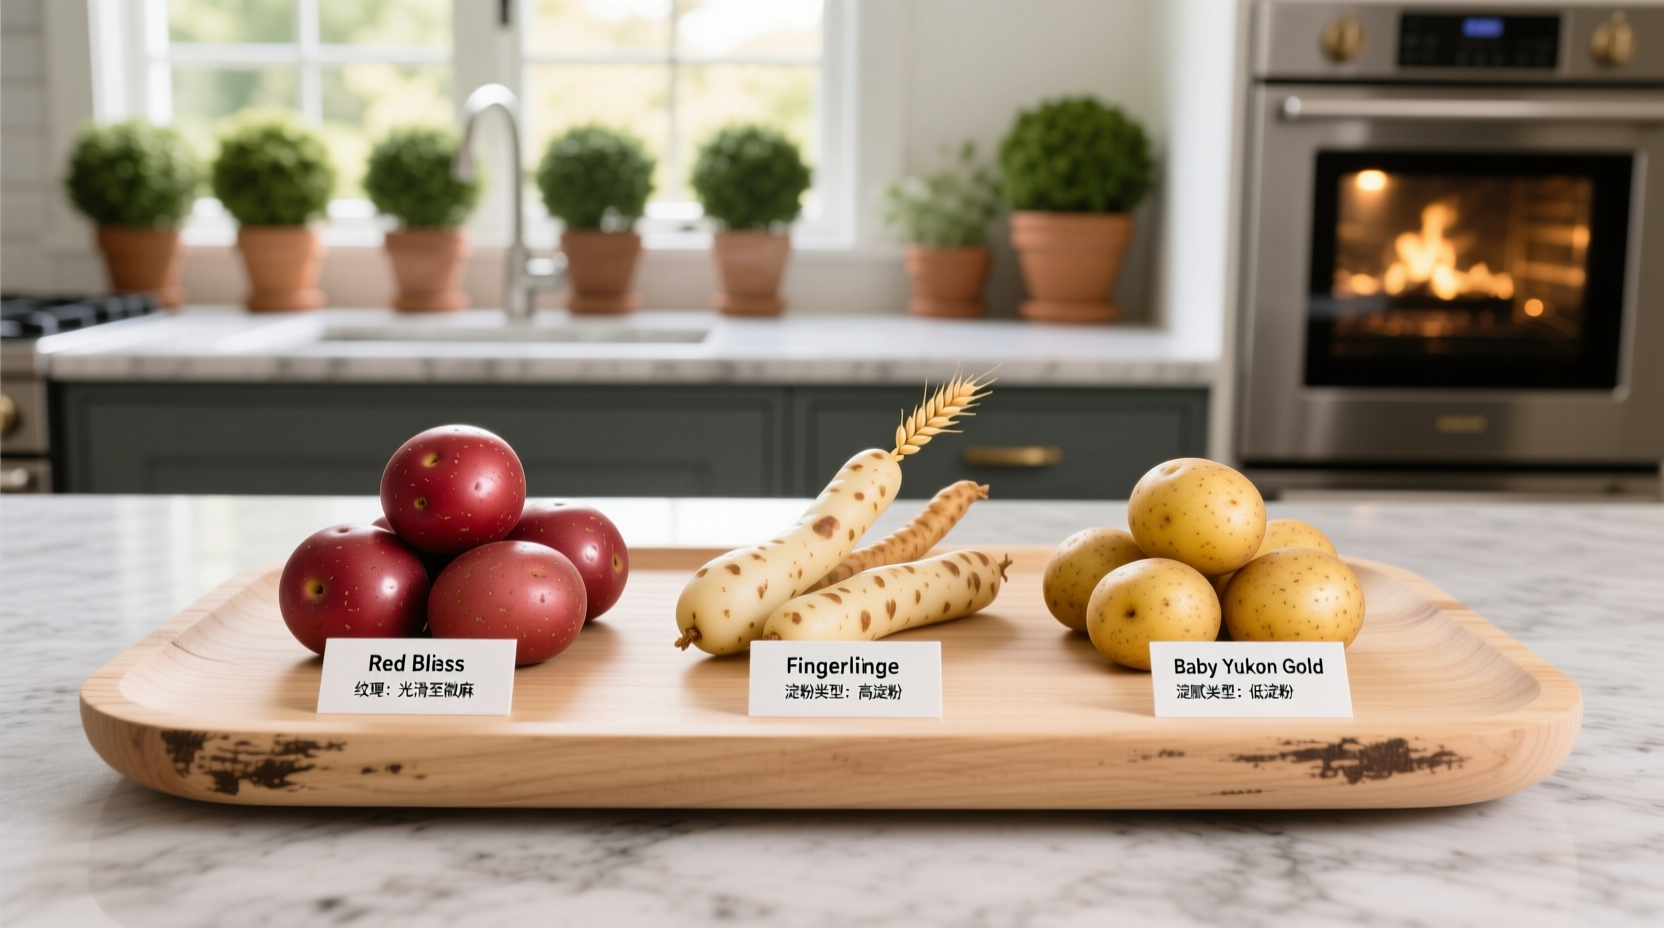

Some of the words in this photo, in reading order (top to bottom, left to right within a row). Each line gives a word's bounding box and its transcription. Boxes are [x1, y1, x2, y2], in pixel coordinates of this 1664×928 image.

[368, 653, 407, 672] Red
[1174, 657, 1218, 679] Baby
[1221, 657, 1278, 675] Yukon
[1282, 657, 1324, 675] Gold
